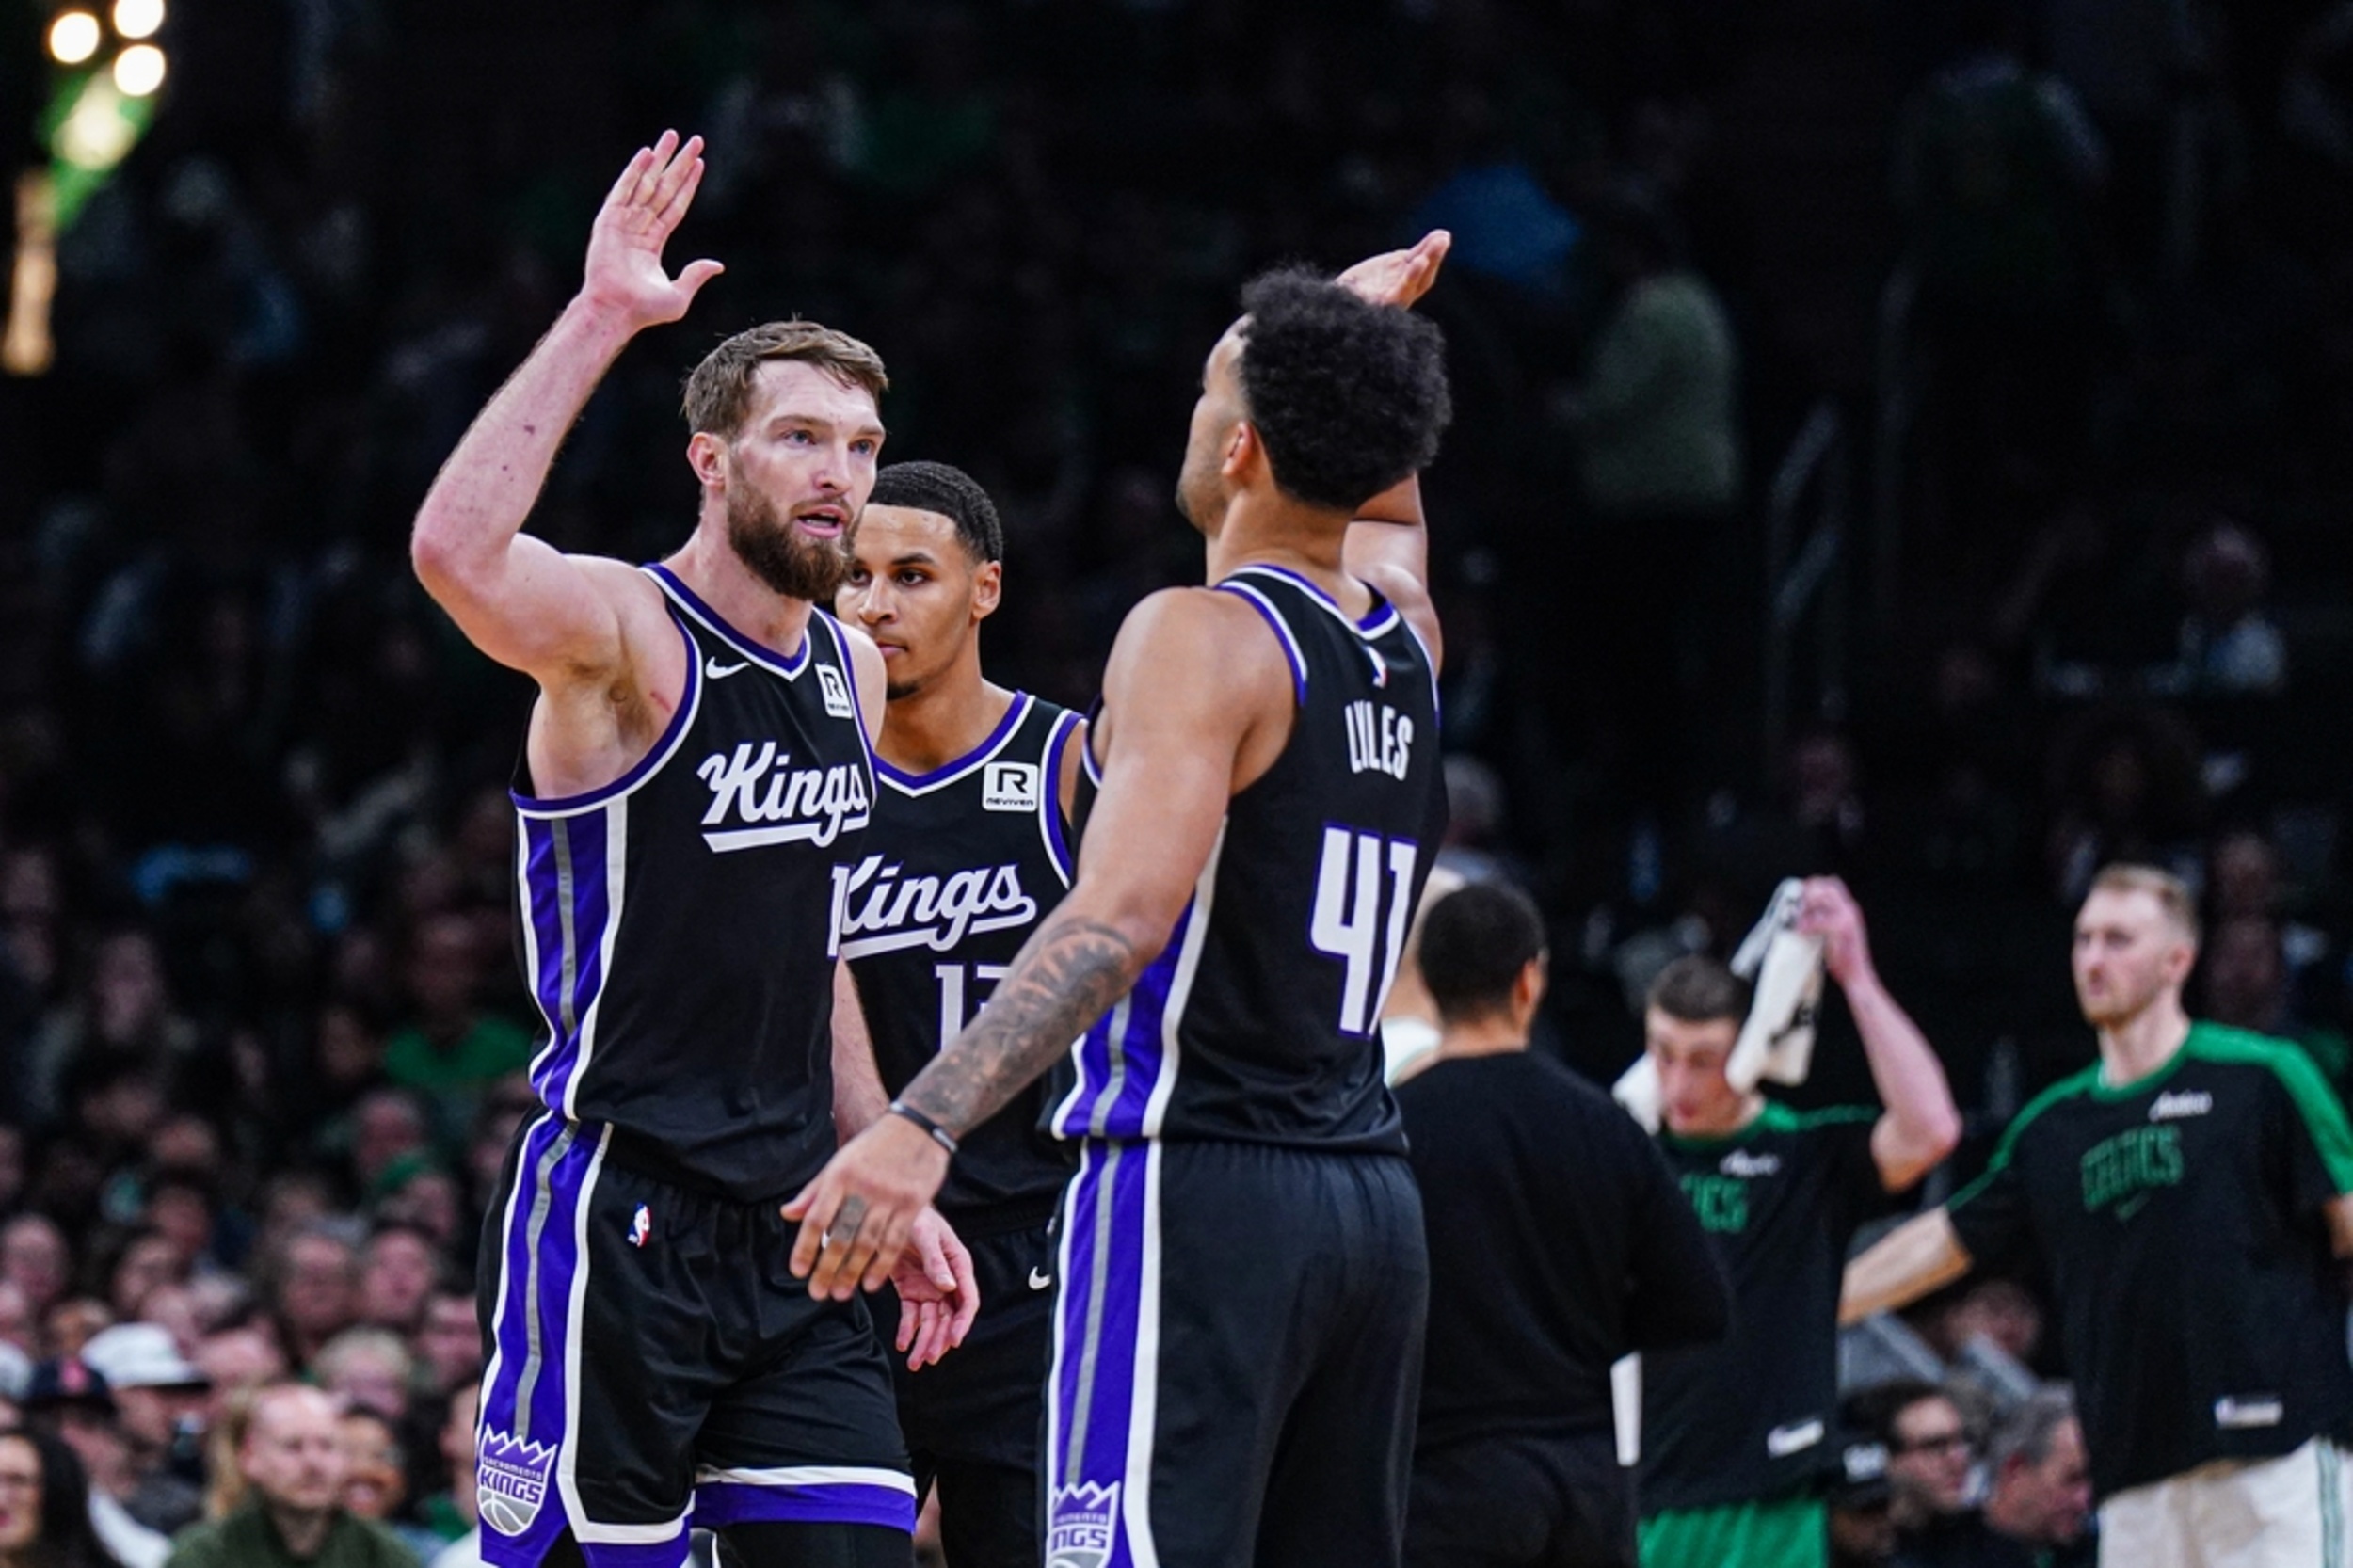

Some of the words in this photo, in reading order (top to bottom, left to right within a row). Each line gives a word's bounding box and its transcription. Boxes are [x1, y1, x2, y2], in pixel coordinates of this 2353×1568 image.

[997, 768, 1028, 794] R
[1344, 699, 1414, 781] LYLES
[696, 741, 870, 853] Kings
[1309, 824, 1417, 1037] 41
[481, 1467, 542, 1504] KINGS
